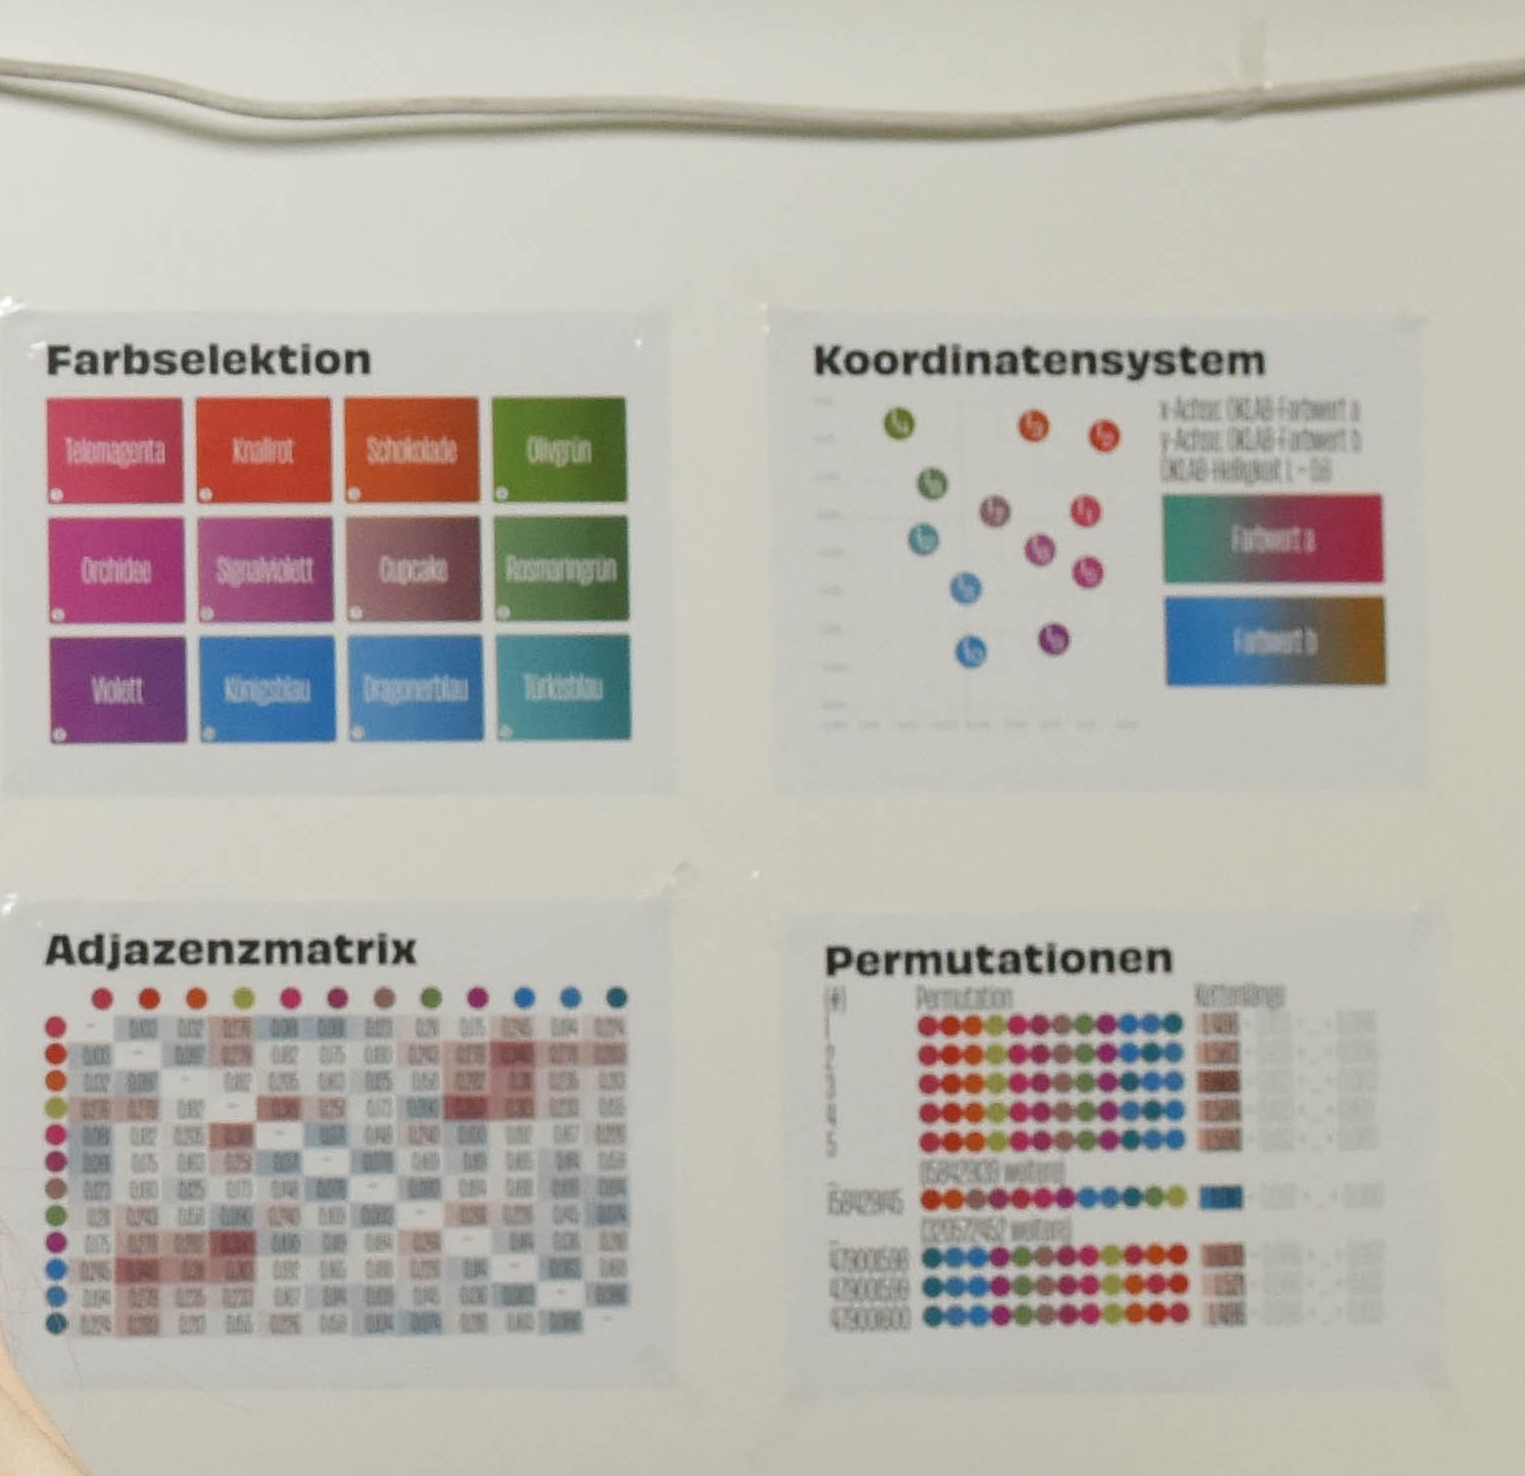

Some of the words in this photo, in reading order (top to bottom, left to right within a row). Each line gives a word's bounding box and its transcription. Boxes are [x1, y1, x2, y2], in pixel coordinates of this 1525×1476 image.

[47, 343, 371, 376] Farbselektion
[814, 344, 1265, 382] Koordinatensystem
[45, 933, 416, 971] Adjazenzmatrix
[825, 942, 1174, 979] Permutationen
